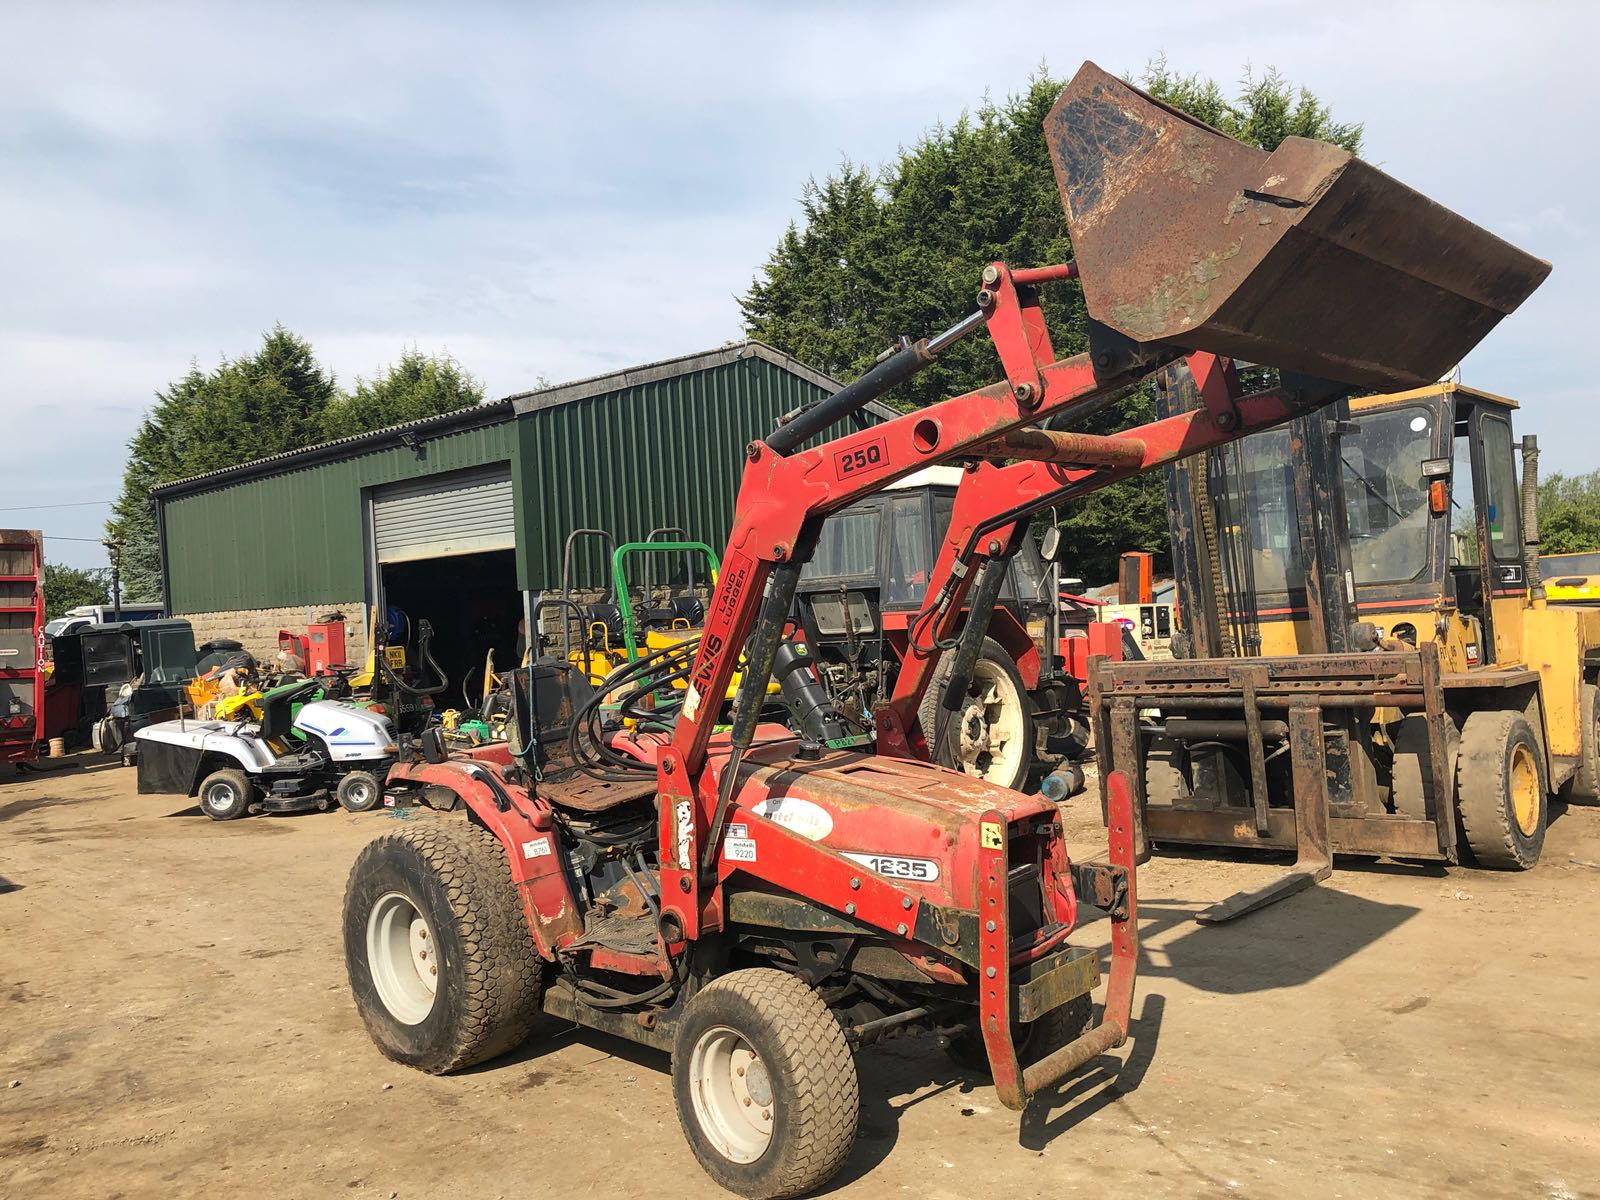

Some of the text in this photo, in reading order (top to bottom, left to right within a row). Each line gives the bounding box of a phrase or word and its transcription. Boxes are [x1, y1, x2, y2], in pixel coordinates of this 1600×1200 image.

[719, 572, 736, 613] LAND
[723, 569, 746, 626] LUGGER
[693, 633, 723, 711] EWIS
[734, 849, 754, 859] 9220
[870, 858, 927, 878] 1235
